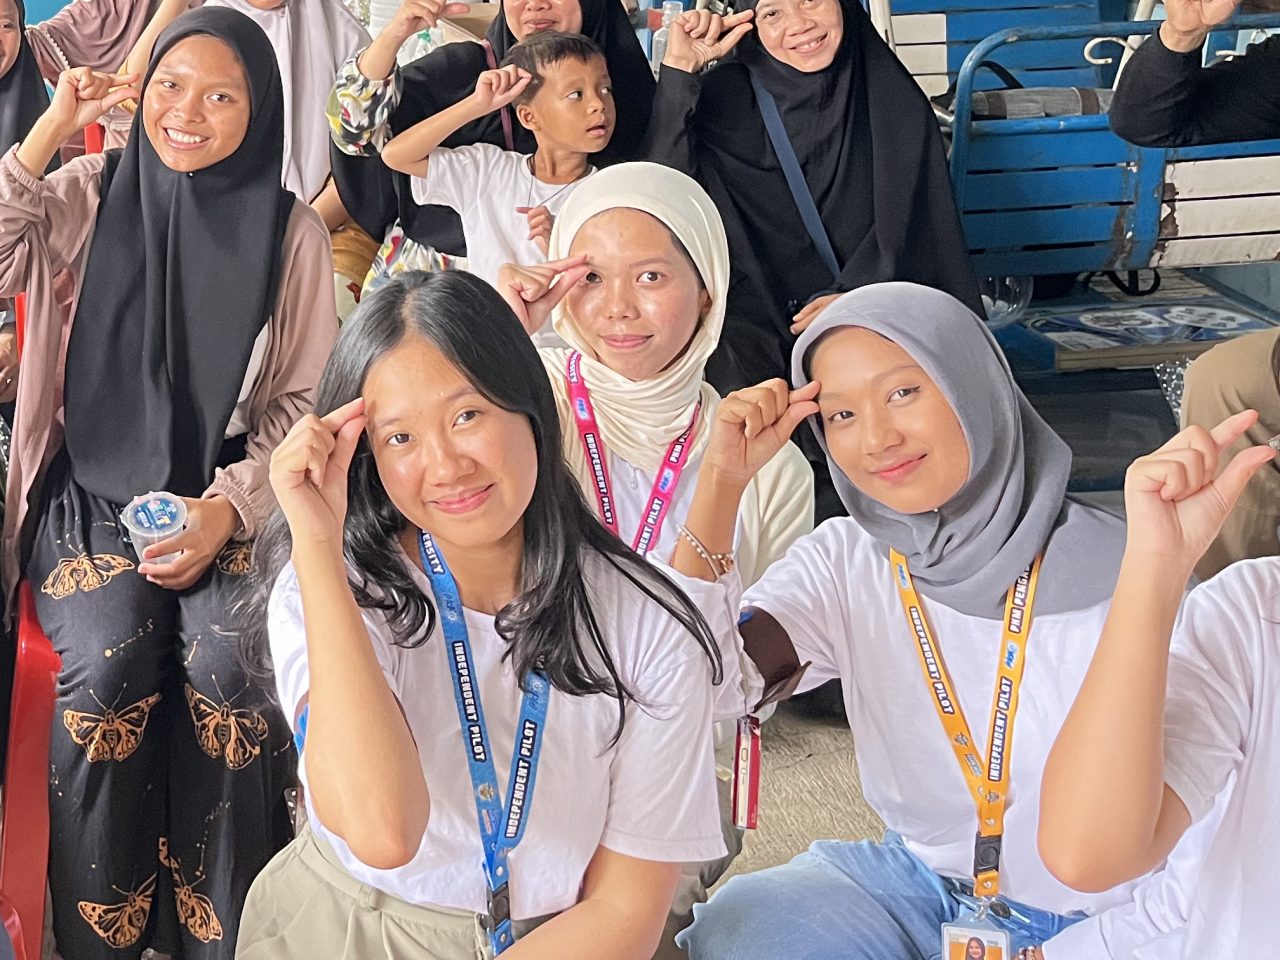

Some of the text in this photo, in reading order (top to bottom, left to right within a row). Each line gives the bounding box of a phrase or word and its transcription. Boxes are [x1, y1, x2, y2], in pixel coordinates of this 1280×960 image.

[586, 433, 613, 524] INDEPENDENT PILOT
[647, 498, 663, 526] PILOT
[910, 607, 954, 714] INDEPENDENT PILOT
[1010, 608, 1022, 633] PKM
[454, 642, 485, 761] INDEPENDENT PILOT
[989, 677, 1012, 781] INDEPENDENT PILOT
[506, 760, 530, 837] INDEPENDENT
[521, 721, 536, 757] PILOT
